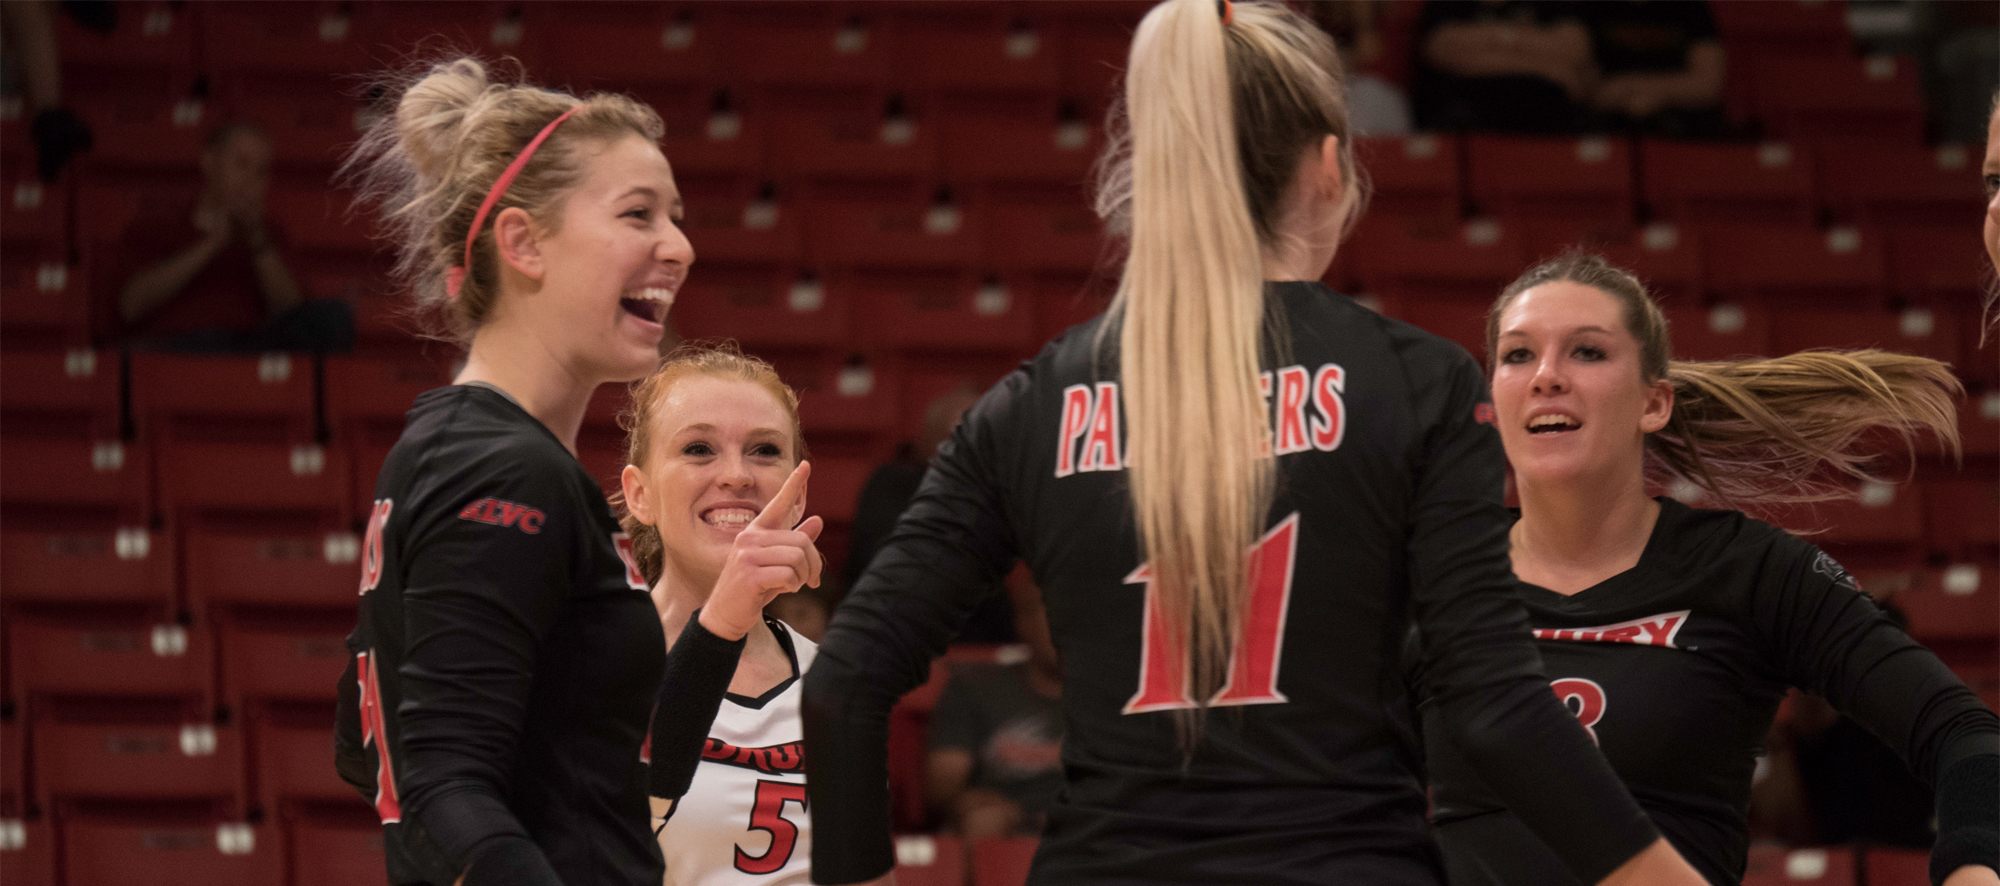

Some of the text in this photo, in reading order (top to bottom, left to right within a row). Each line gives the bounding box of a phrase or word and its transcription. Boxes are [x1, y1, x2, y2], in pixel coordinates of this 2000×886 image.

[1055, 363, 1346, 478] PARS
[1121, 511, 1300, 715] 11
[700, 737, 806, 775] DRU
[734, 779, 807, 875] 5
